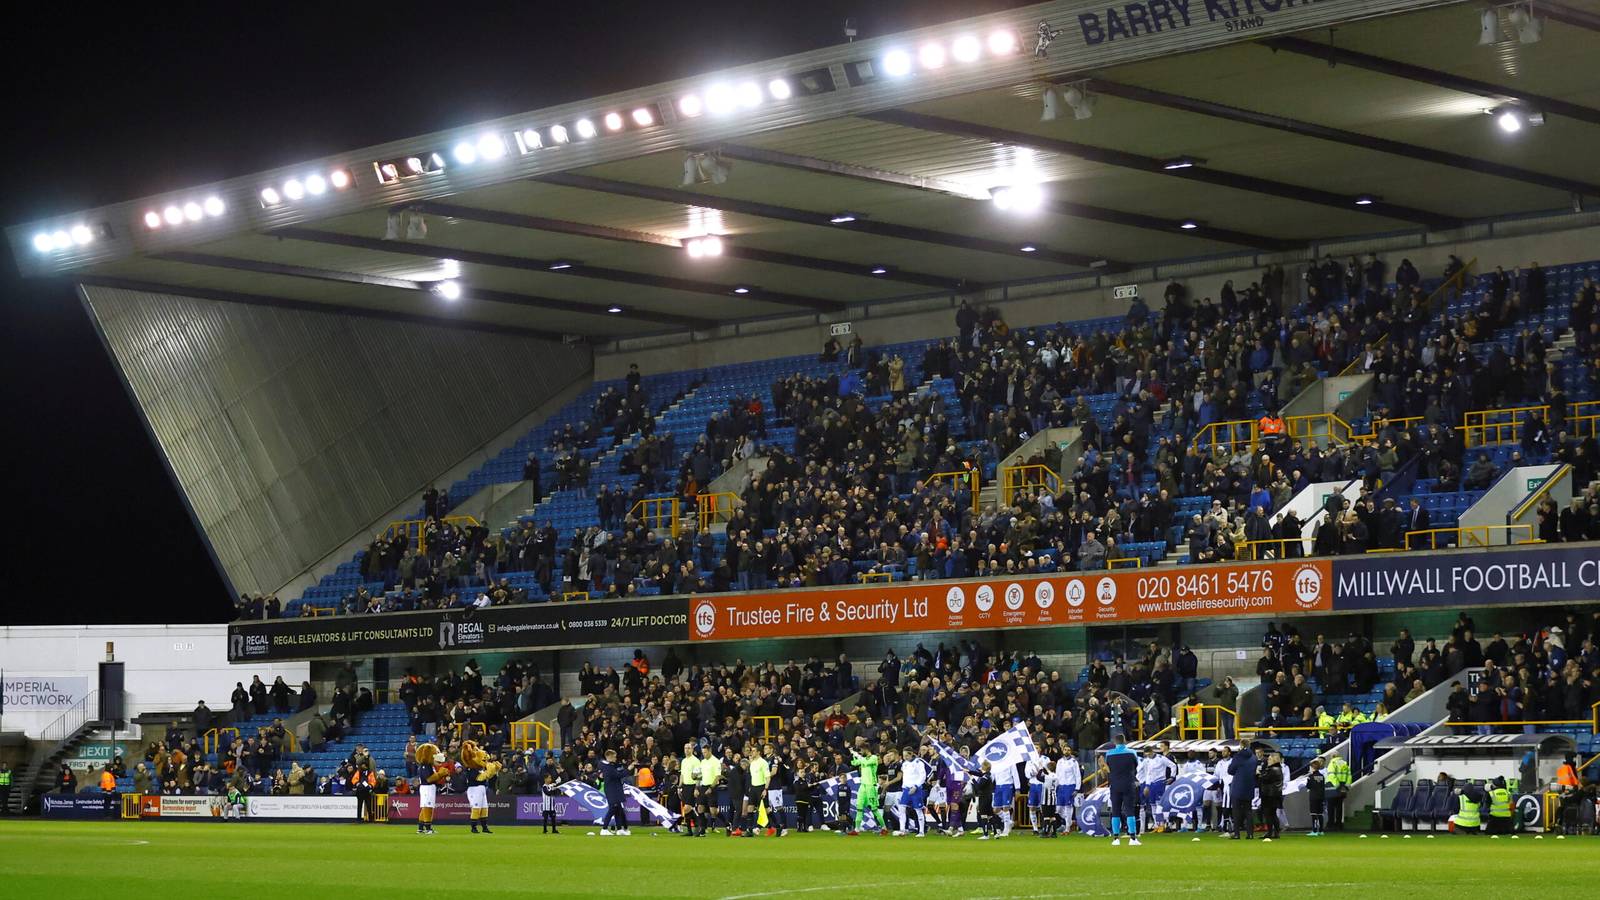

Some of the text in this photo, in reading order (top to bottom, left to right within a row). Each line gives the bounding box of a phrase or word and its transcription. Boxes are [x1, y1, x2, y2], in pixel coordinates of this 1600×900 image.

[1078, 0, 1191, 45] BARRY
[1225, 16, 1264, 32] STAND
[1138, 576, 1170, 598] 020
[1176, 573, 1219, 596] 8461
[1228, 570, 1272, 594] 5476
[1298, 578, 1318, 594] tfs
[1338, 568, 1444, 597] MILLWALL
[1452, 562, 1571, 592] FOOTBALL
[726, 606, 781, 626] Trustee
[786, 602, 814, 622] Fire
[820, 602, 830, 622] &
[836, 599, 898, 624] Security
[904, 597, 928, 618] Ltd
[1138, 596, 1272, 612] www.trusteefiresecurity.com
[611, 614, 687, 628] 24/7 LIFT DOCTOR
[698, 612, 712, 625] tfs
[458, 622, 484, 633] REGAL
[497, 623, 560, 633] info@regalelevators.co.uk
[246, 635, 268, 645] REGAL
[274, 628, 433, 645] REGAL ELEVATORS & LIFT CONSULTANTS LTD
[2, 682, 58, 692] MPERIAL
[87, 746, 110, 756] EXIT
